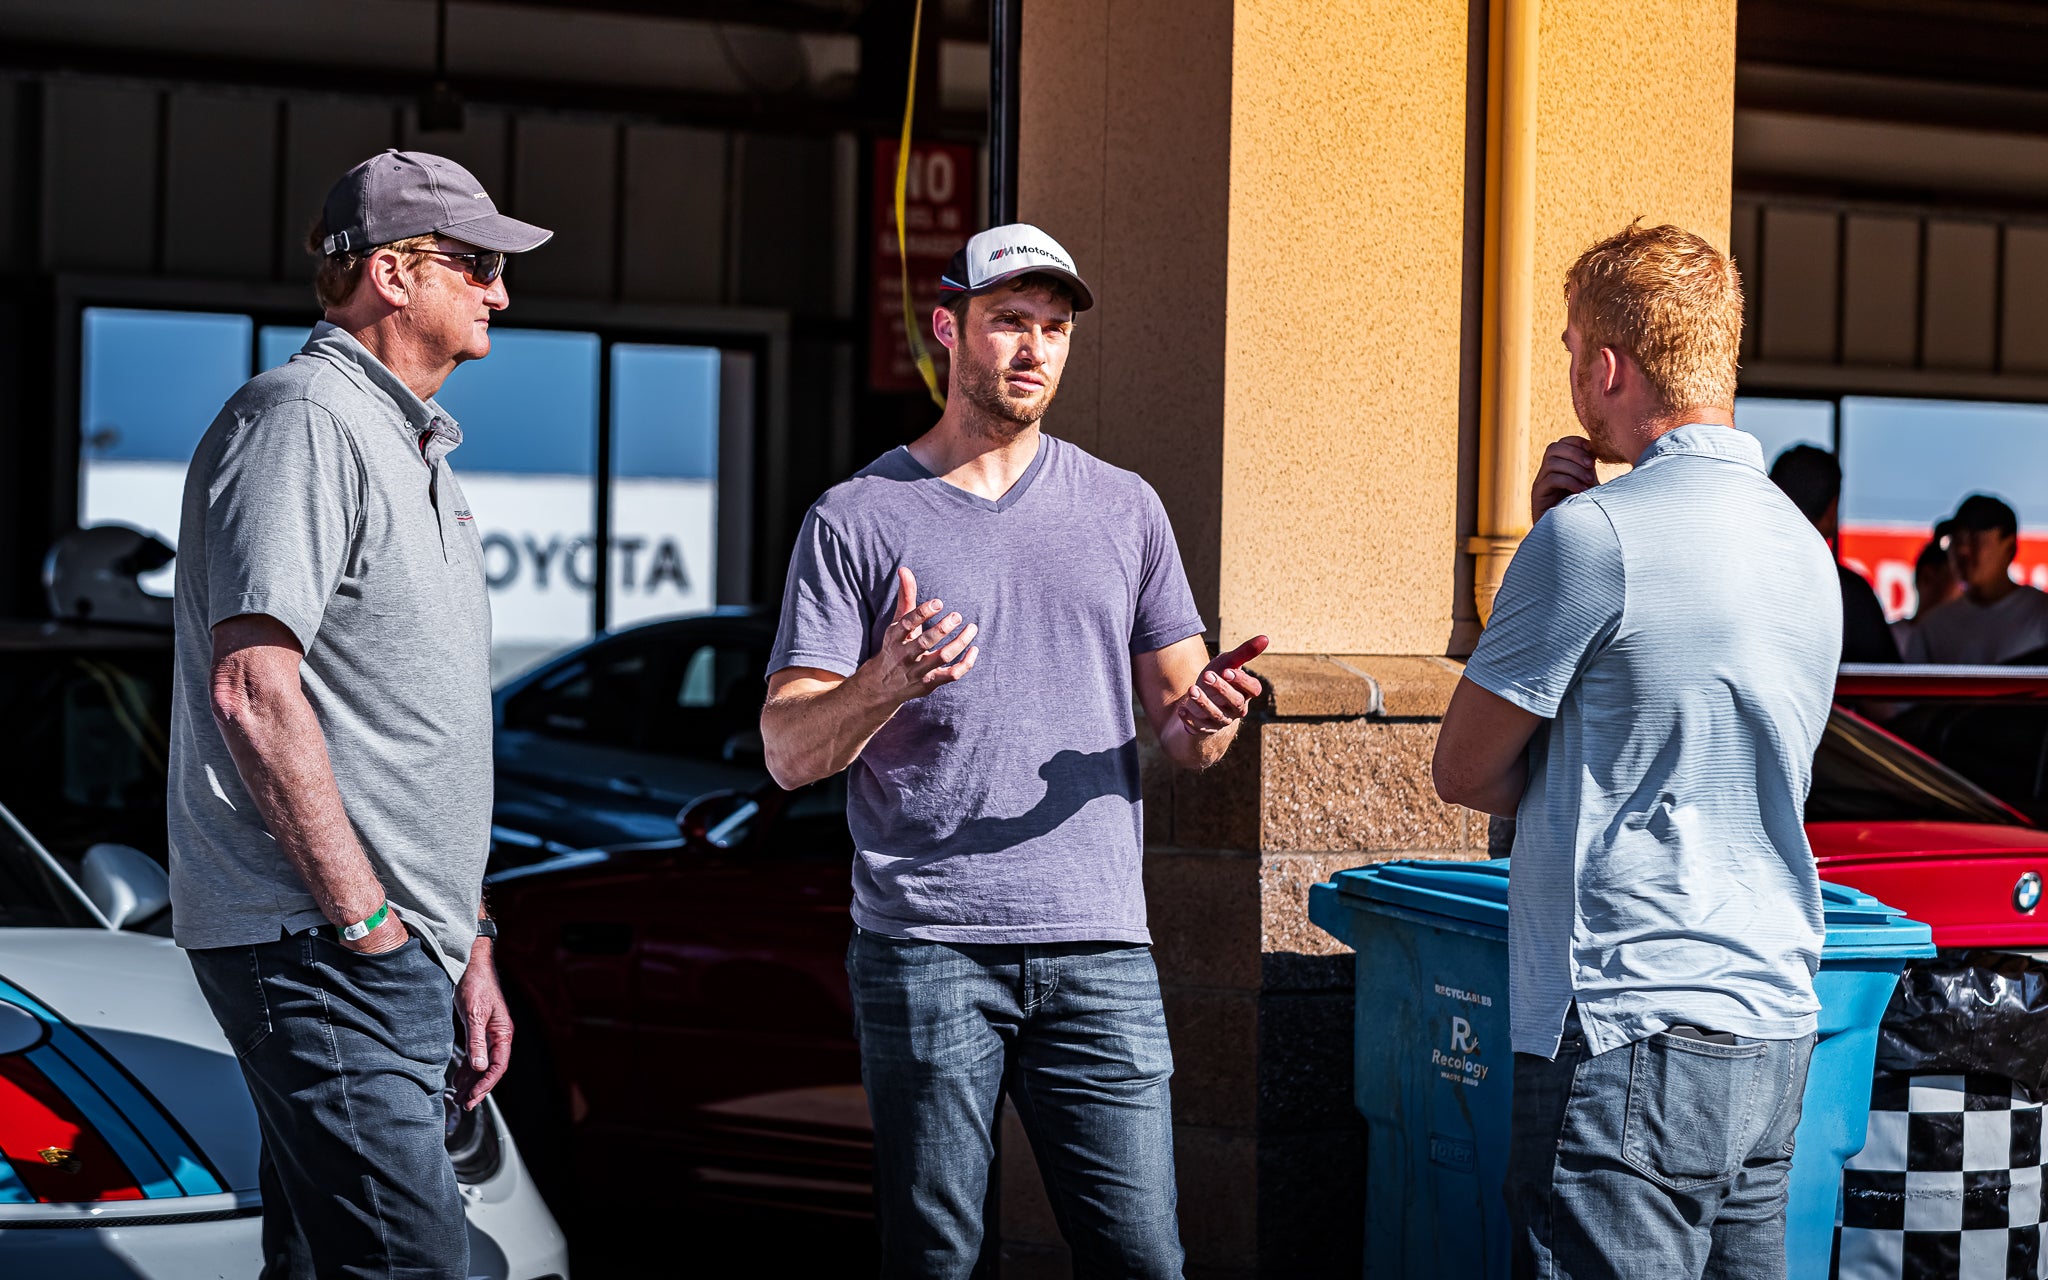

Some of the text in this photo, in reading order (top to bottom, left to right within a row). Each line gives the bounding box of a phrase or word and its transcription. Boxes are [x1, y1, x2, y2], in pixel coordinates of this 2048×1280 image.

[482, 532, 692, 594] OYOTA
[1434, 984, 1492, 1007] RECYCLABLES
[1432, 1048, 1488, 1079] Recology
